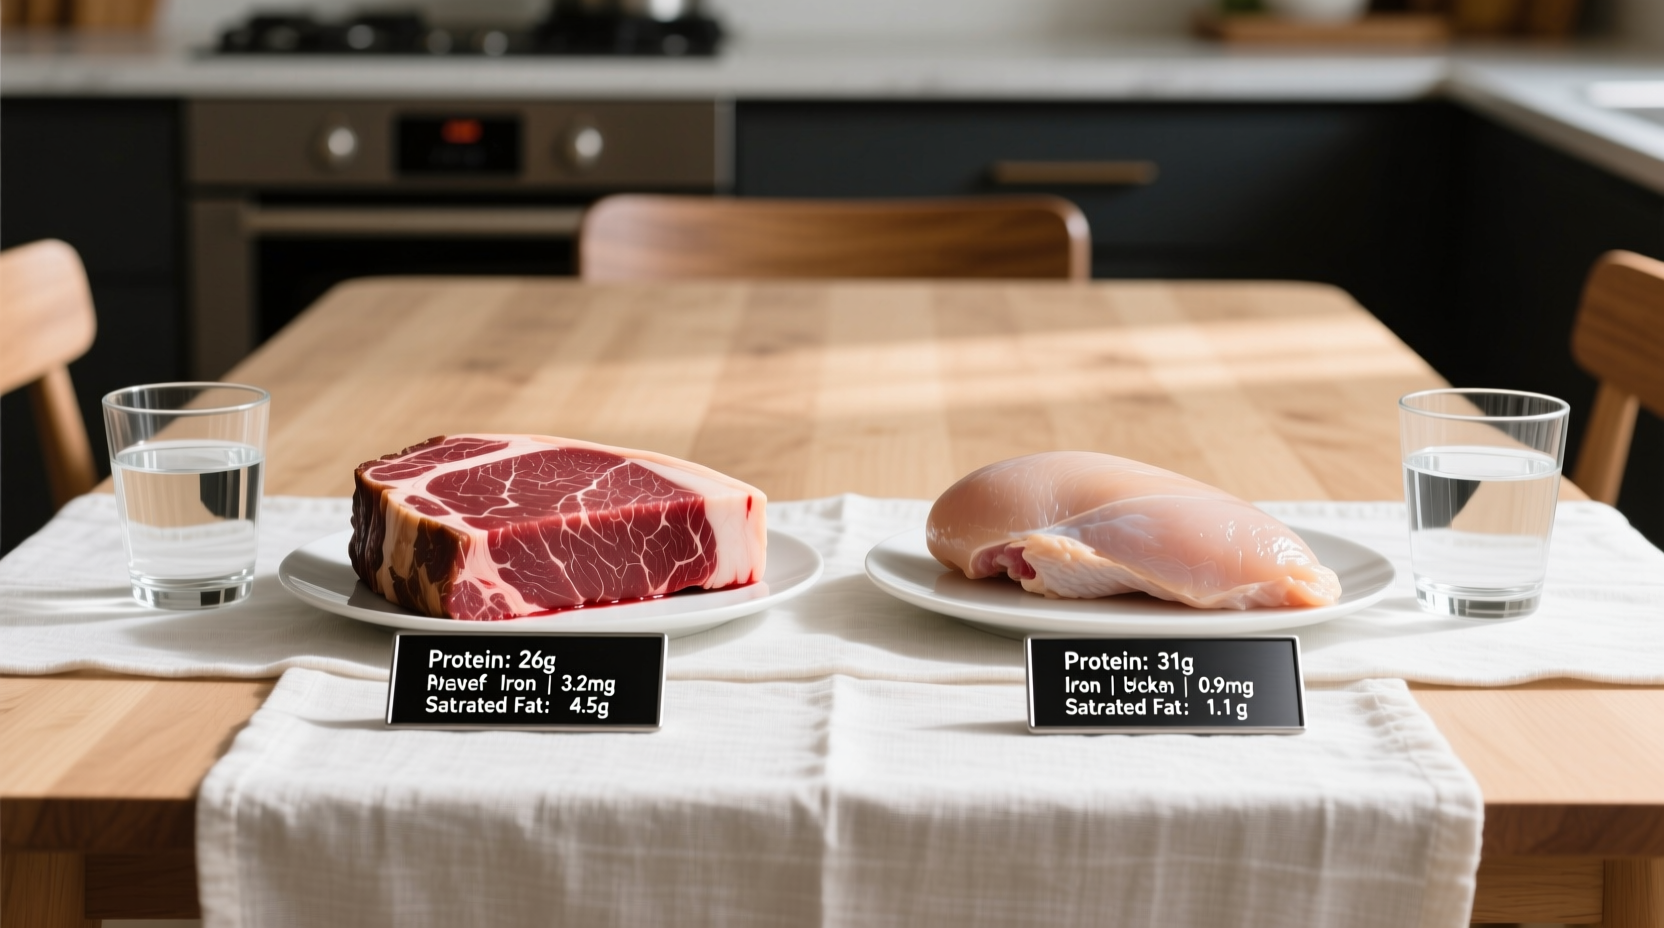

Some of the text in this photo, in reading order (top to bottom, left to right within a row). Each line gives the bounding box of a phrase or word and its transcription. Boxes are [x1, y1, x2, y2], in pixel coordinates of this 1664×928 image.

[428, 649, 556, 674] Protein: 26g
[1064, 651, 1194, 675] Protein: 31g
[500, 674, 537, 691] Iron
[560, 674, 616, 697] 3.2mg
[1065, 676, 1101, 694] Iron
[1198, 676, 1255, 698] 0.9mg
[425, 696, 609, 719] Satrated Fat: 4.5g
[1065, 698, 1147, 716] Satrated
[1153, 698, 1189, 716] Fat:
